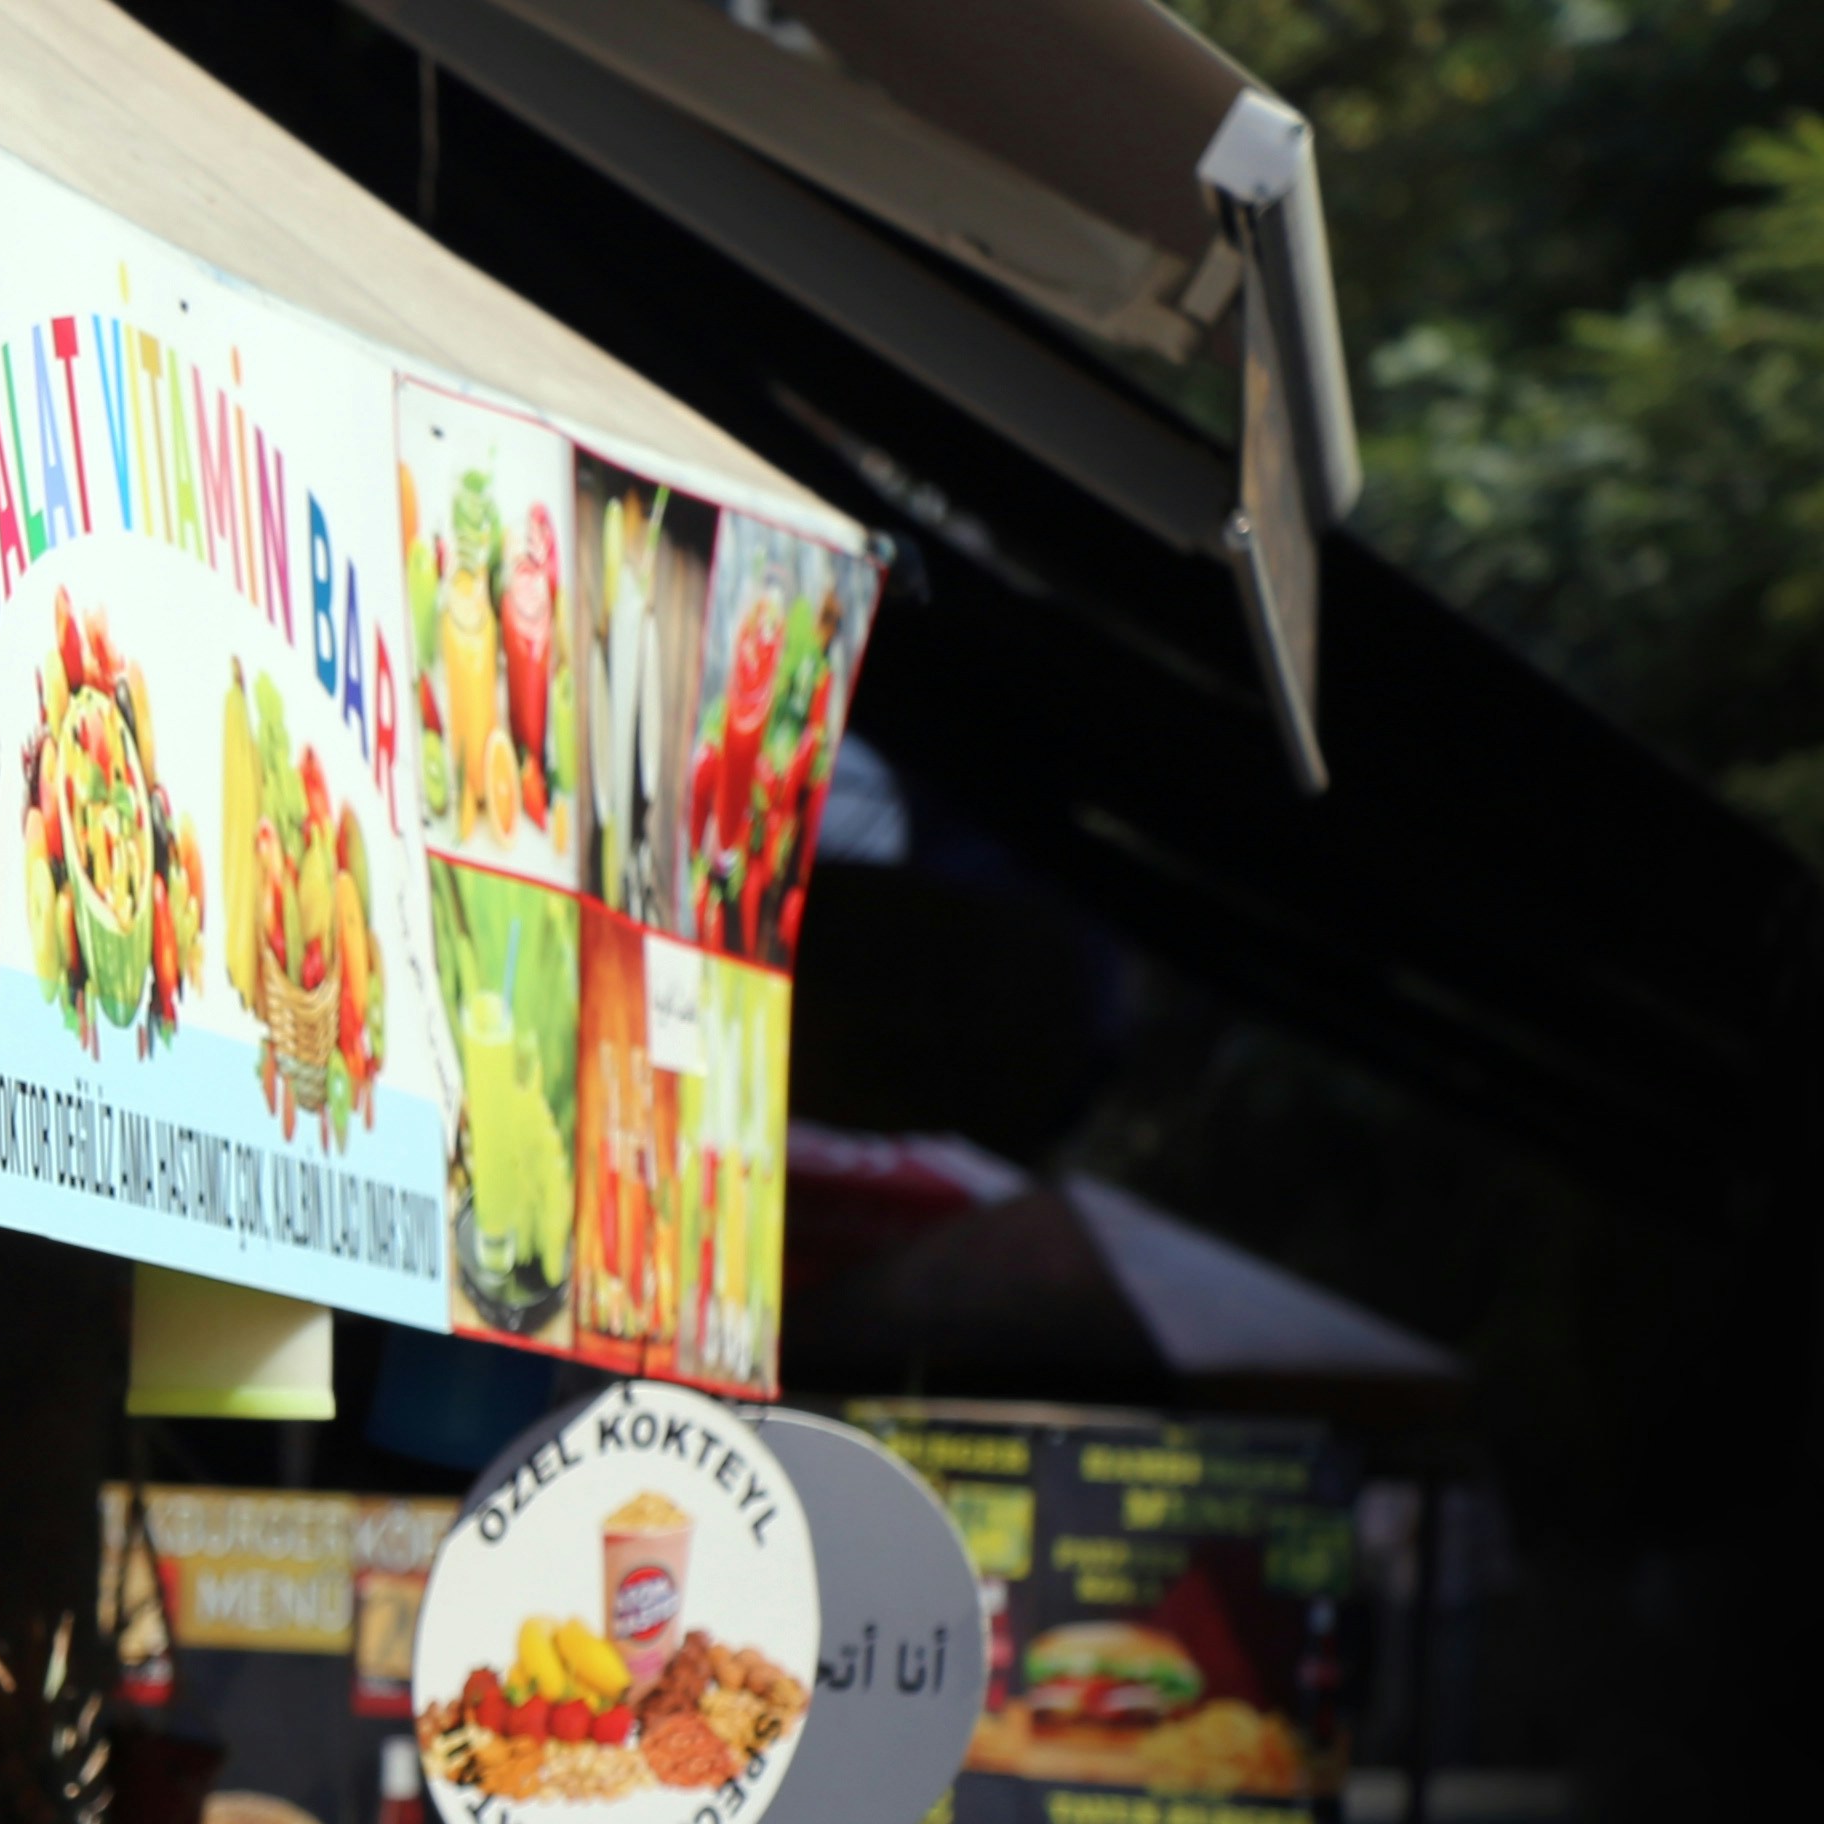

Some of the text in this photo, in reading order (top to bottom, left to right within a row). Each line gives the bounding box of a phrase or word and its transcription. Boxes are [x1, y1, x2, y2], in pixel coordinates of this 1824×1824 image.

[92, 258, 296, 650] VİTAMİN
[308, 488, 402, 836] BAR
[118, 1110, 154, 1210] AMA
[476, 1411, 783, 1549] ÖZEL KOKTEYL
[894, 1625, 949, 1698] أنا
